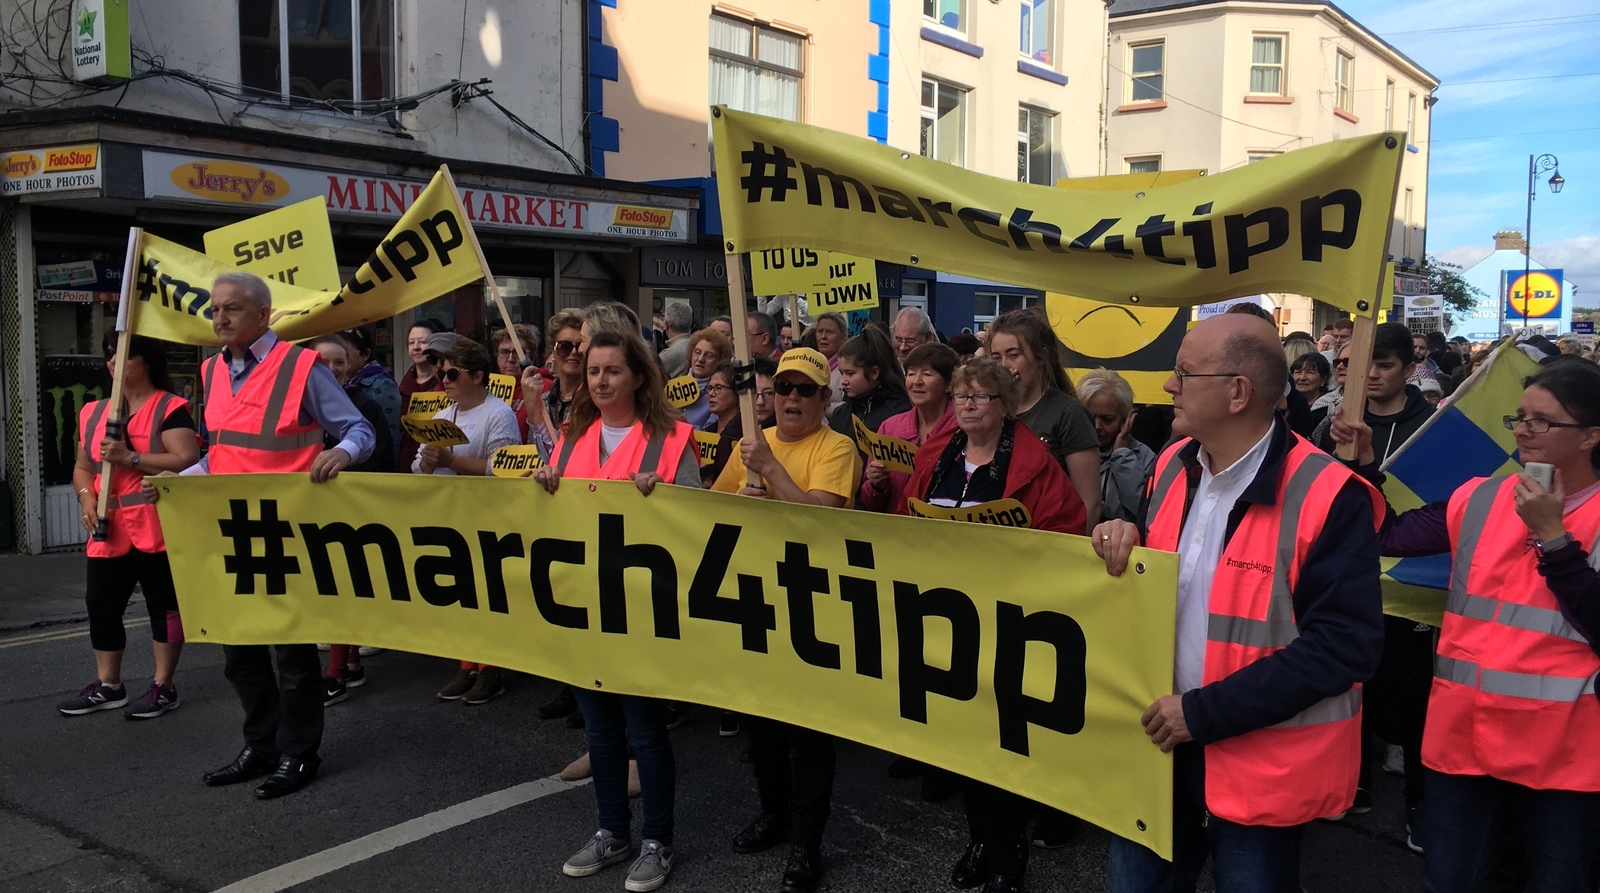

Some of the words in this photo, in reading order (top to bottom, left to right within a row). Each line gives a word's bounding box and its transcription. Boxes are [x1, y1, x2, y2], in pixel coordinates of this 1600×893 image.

[74, 42, 101, 56] National
[77, 55, 99, 67] Lottery
[6, 155, 36, 176] Jerry's
[49, 151, 92, 167] FotoStop
[3, 181, 21, 191] ONE
[26, 178, 52, 190] HOUR
[56, 174, 95, 188] PHOTOS
[187, 164, 276, 201] Jerry's
[741, 141, 1362, 275] #march4tipp
[619, 209, 667, 226] FotoStop
[607, 226, 623, 234] ONE
[626, 228, 647, 236] HOUR
[650, 229, 678, 238] PHOTOS
[233, 229, 304, 266] Save
[655, 258, 693, 277] TOM
[759, 249, 785, 270] TO
[791, 248, 819, 267] US
[267, 266, 299, 286] ur
[878, 279, 896, 289] KER
[40, 290, 89, 301] PostPoint
[812, 282, 873, 307] TOWN
[1199, 304, 1219, 314] Proud
[1219, 303, 1227, 313] of
[782, 353, 824, 370] #march4tipp
[488, 379, 513, 402] tipp
[1226, 557, 1272, 574] #march4tipp
[218, 498, 1086, 757] #march4tipp
